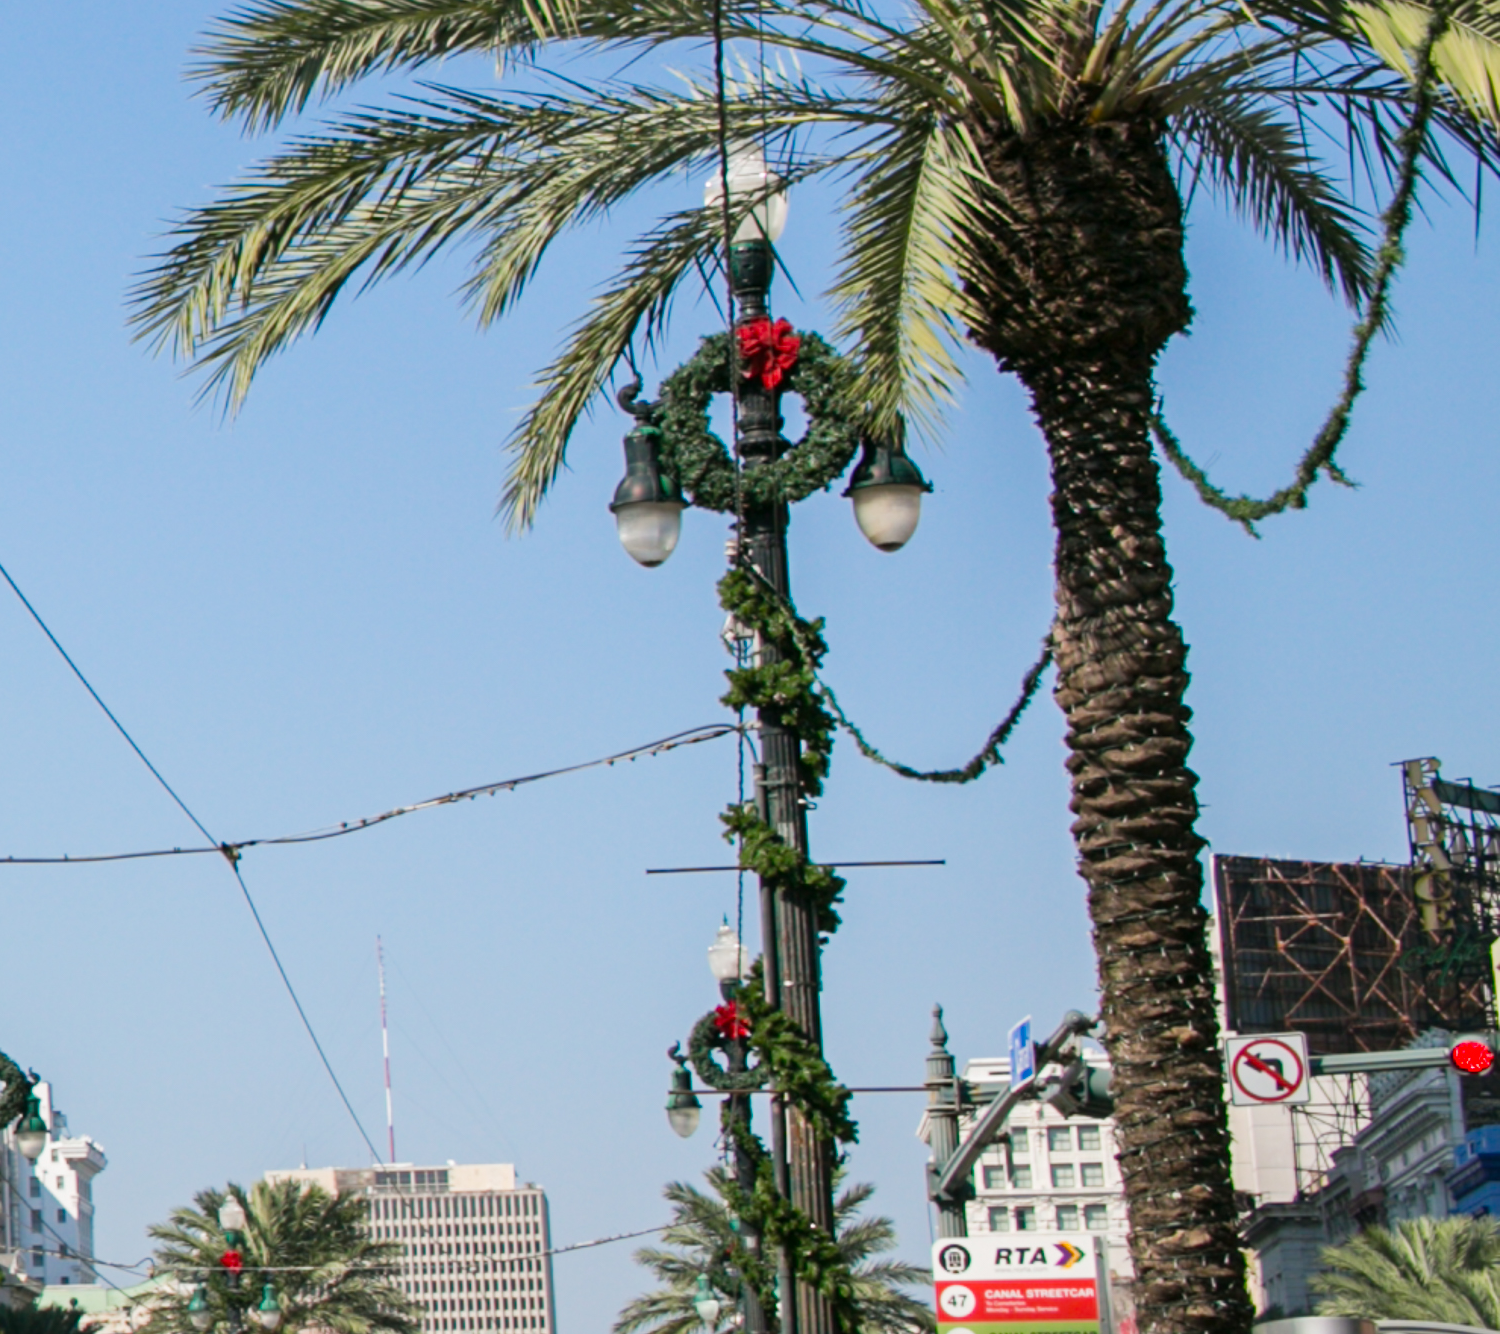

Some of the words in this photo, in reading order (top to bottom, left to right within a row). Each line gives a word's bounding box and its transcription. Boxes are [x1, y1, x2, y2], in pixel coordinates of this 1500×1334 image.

[995, 1247, 1048, 1265] RTA
[984, 1289, 1025, 1300] CANAL
[1026, 1287, 1095, 1299] STREETCAR
[947, 1294, 968, 1308] 47
